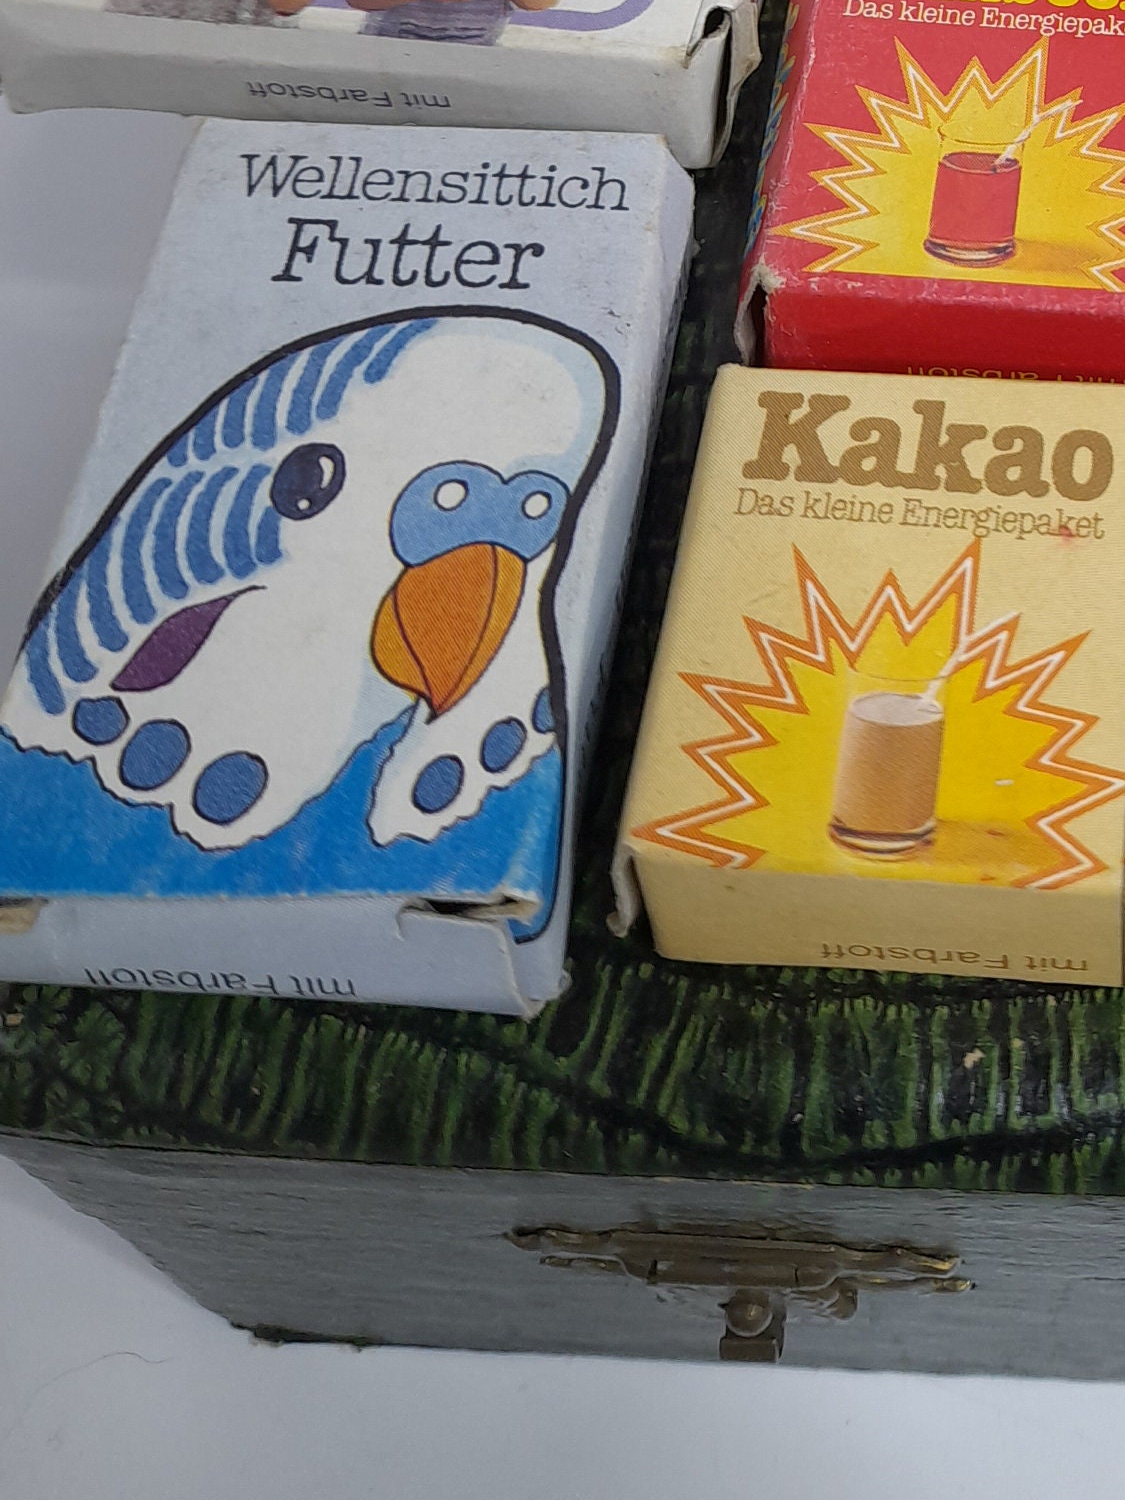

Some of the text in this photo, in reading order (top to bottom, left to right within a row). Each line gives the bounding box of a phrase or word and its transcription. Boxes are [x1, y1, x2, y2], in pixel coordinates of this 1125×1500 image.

[900, 0, 976, 27] kleine
[248, 82, 450, 108] mit Farbstoff
[240, 153, 630, 211] Wellensittich
[271, 217, 545, 289] Futter
[741, 390, 1114, 501] Kakao
[733, 487, 1106, 540] Das kleine Energiepaket
[821, 943, 1089, 972] mit Farbstoff
